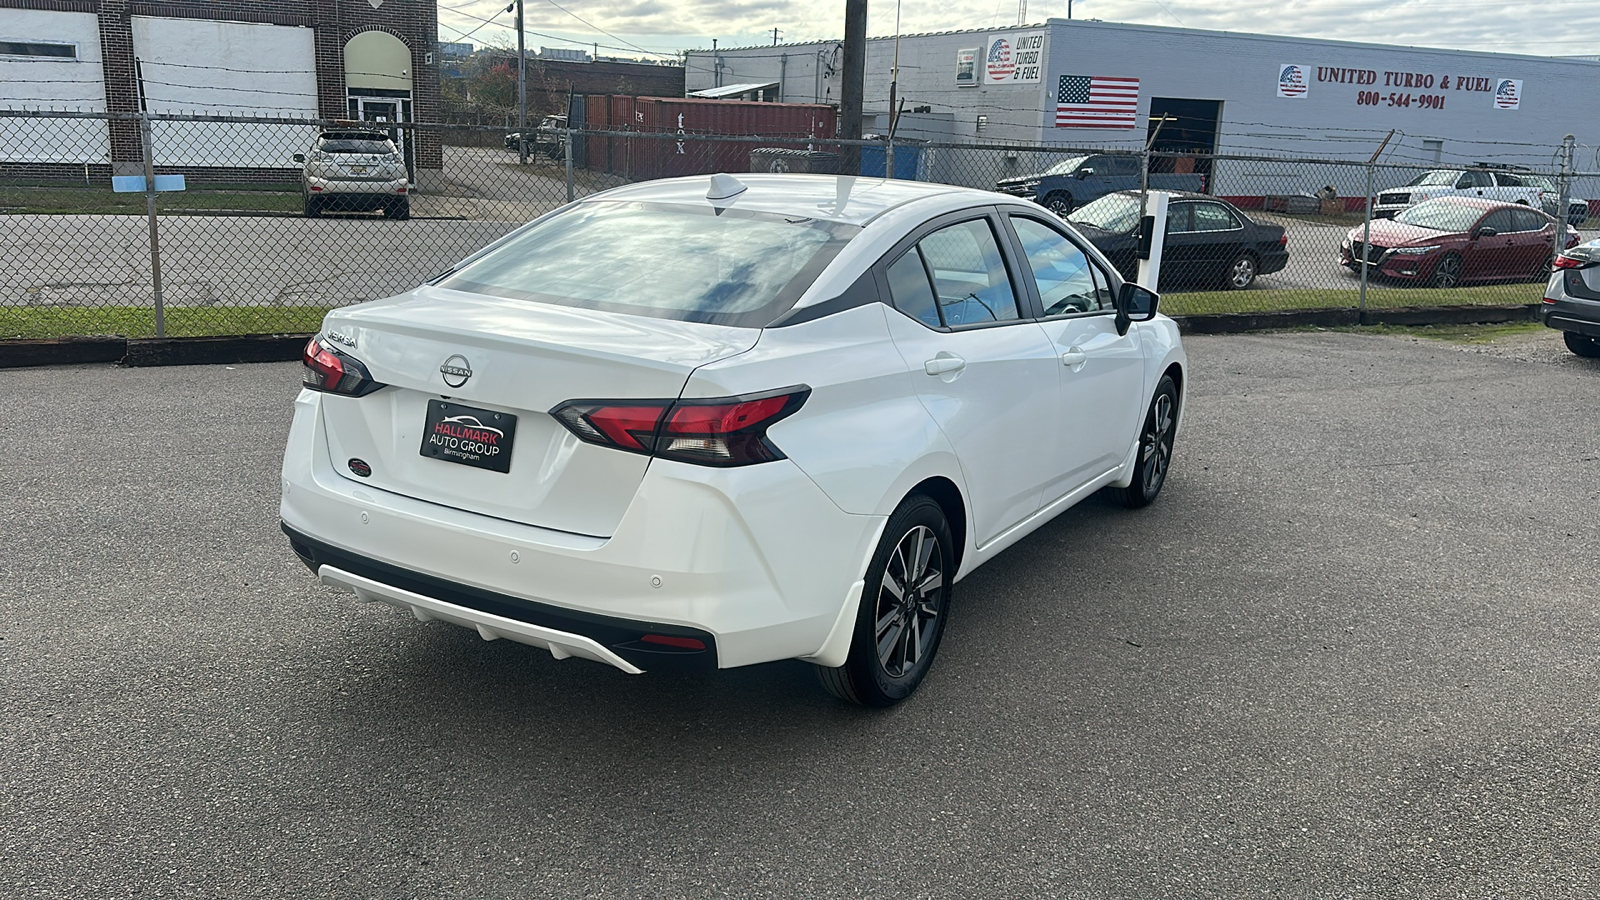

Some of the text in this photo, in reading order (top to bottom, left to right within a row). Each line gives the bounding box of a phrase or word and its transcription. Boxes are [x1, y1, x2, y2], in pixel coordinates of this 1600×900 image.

[1016, 35, 1043, 49] UNITED
[1015, 51, 1038, 64] TURBO
[1013, 67, 1039, 79] & FUEL
[1317, 66, 1493, 93] UNITED TURBO & FUEL
[1356, 90, 1446, 110] 800-544-9901
[327, 328, 359, 349] VERSA
[440, 365, 472, 377] NISSAN
[434, 422, 499, 445] HALLMARK
[429, 434, 500, 457] AUTO GROUP
[443, 447, 481, 461] Birmingham
